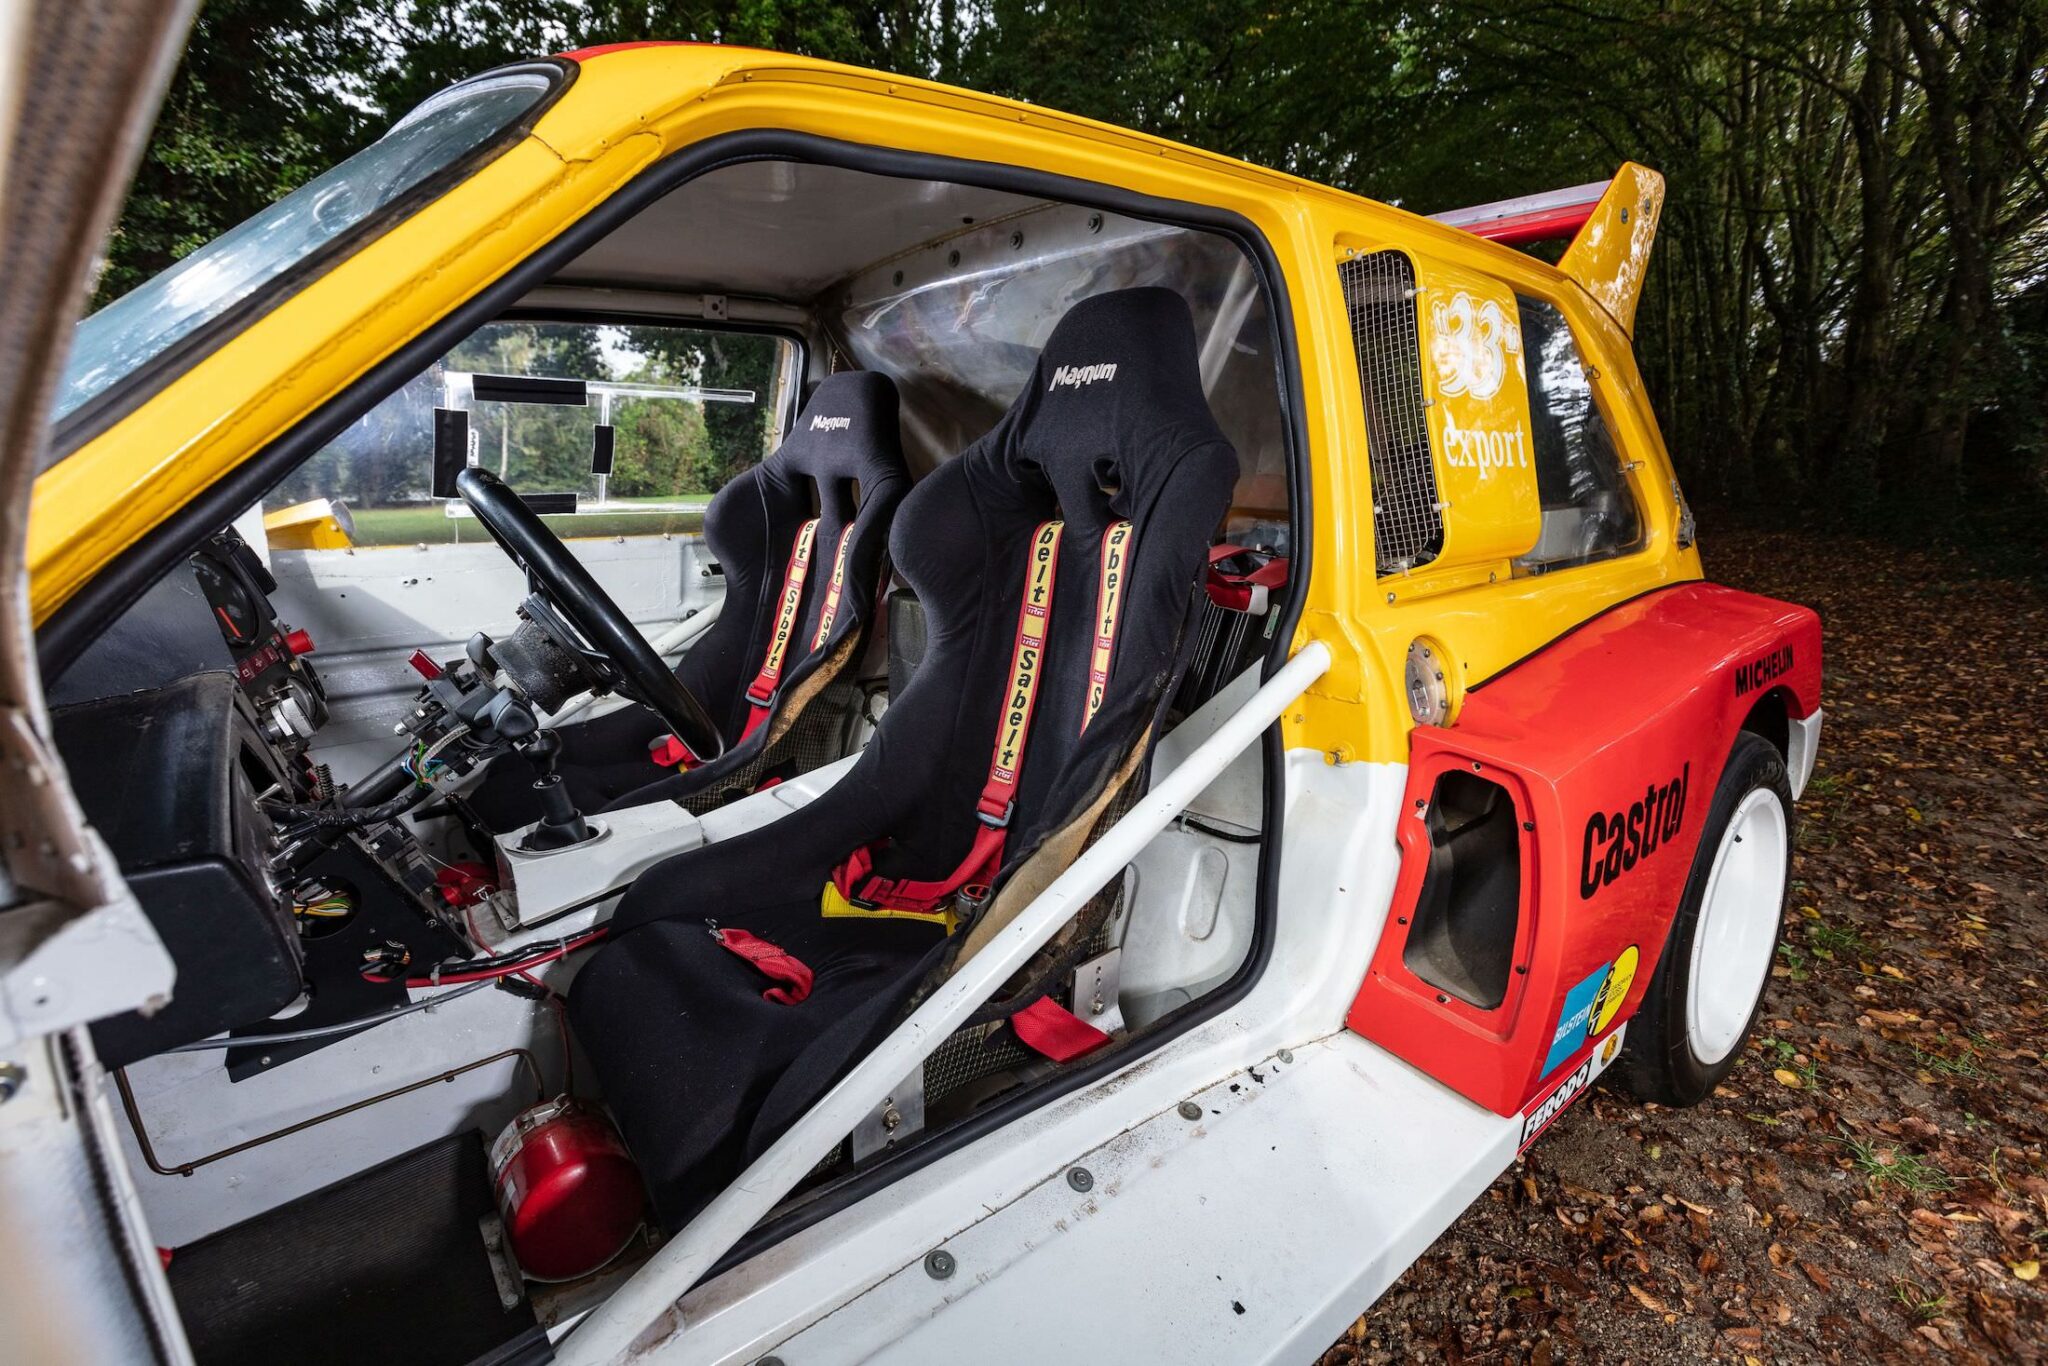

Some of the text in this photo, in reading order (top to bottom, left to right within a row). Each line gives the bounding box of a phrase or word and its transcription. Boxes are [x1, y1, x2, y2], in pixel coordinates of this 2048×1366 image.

[1048, 363, 1118, 392] Magnum
[809, 414, 851, 432] Magnum
[1443, 406, 1528, 480] export
[770, 590, 798, 667] Sabelt
[1003, 650, 1036, 766] Sabelt
[1735, 644, 1794, 698] MICHELIN
[1580, 761, 1690, 900] Castrol
[1553, 1001, 1592, 1046] BILSTEIN
[1523, 1064, 1589, 1143] FERODO
